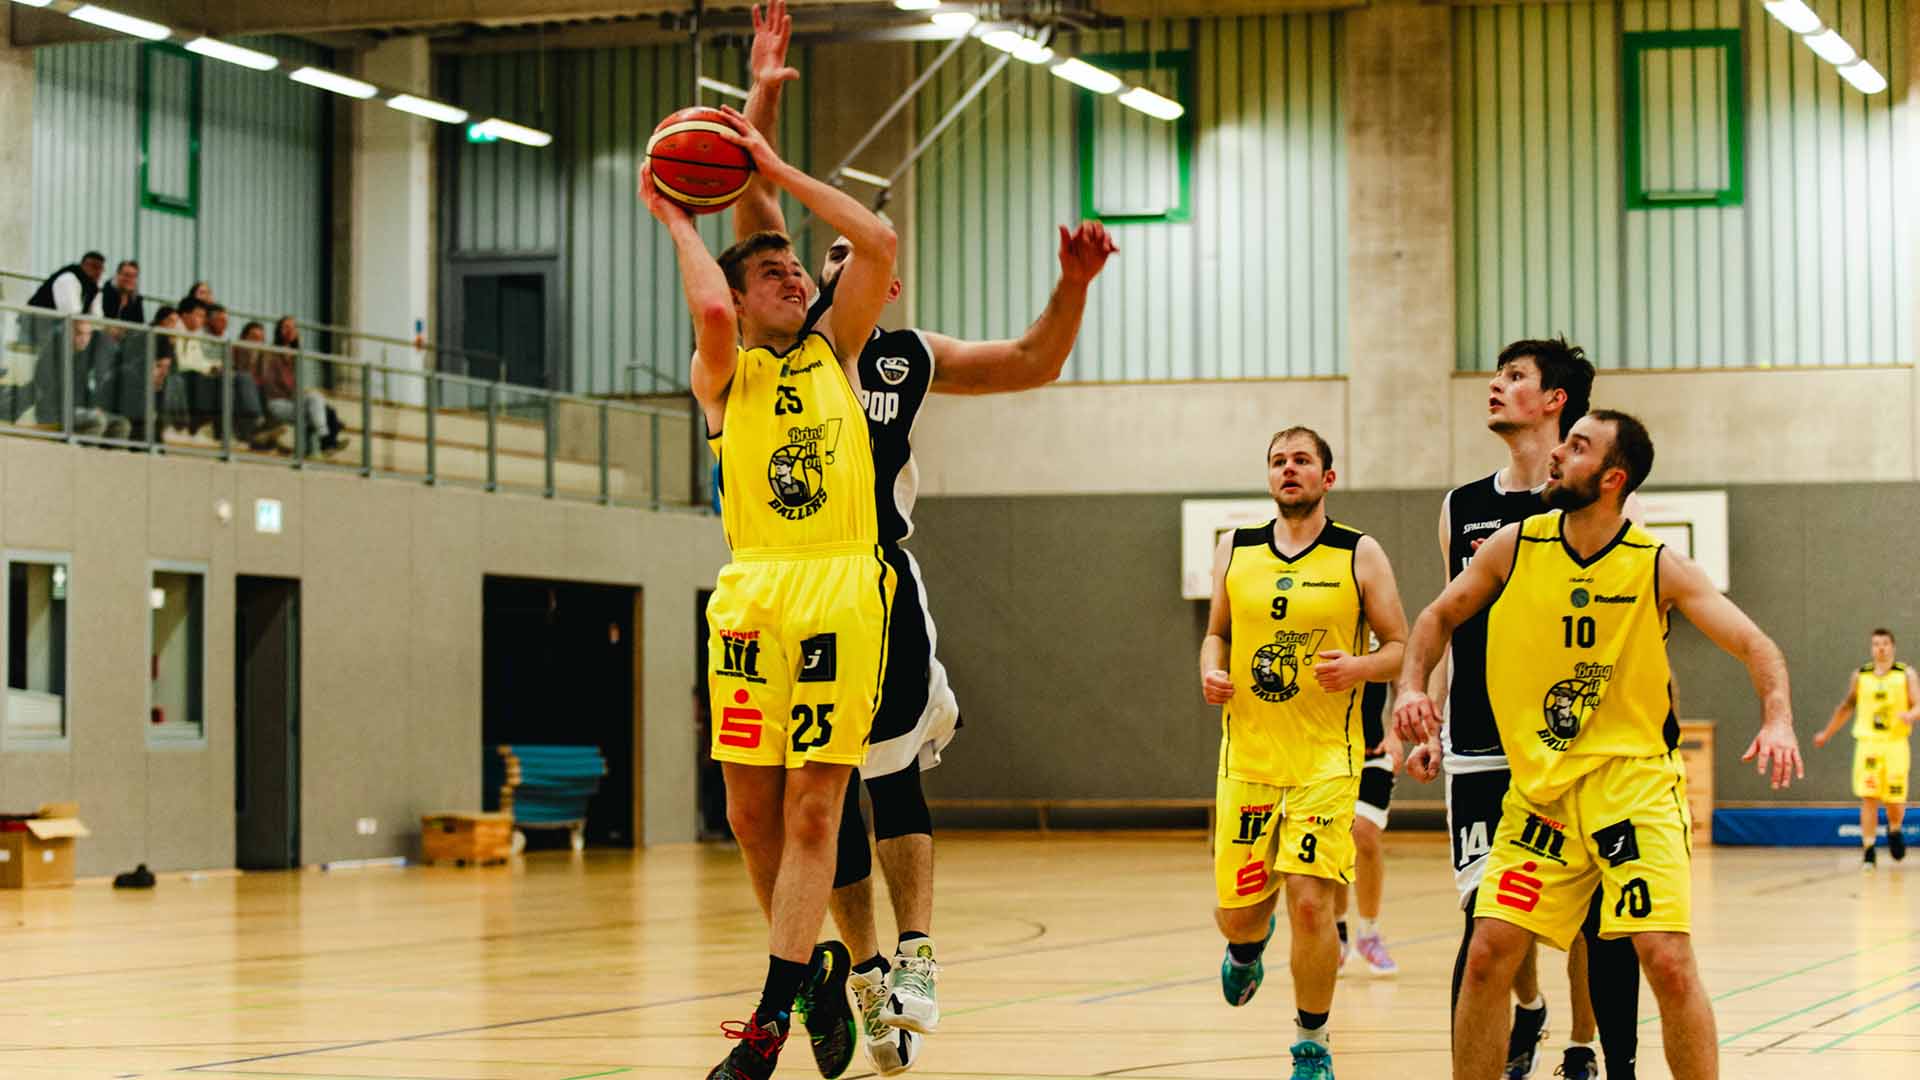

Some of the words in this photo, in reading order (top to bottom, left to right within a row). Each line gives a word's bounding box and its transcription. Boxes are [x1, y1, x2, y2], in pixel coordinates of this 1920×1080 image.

[775, 384, 804, 416] 25
[788, 424, 825, 443] Bring
[805, 441, 817, 456] it
[804, 456, 821, 470] on
[768, 488, 828, 520] BALLERS
[1463, 519, 1503, 535] SPALDING
[1271, 596, 1289, 620] 9
[1274, 630, 1310, 647] Bring
[1562, 615, 1597, 649] 10
[1574, 661, 1614, 682] Bring
[791, 703, 835, 752] 25
[1536, 728, 1575, 752] BALL
[1240, 803, 1274, 813] clever
[1298, 833, 1318, 864] 9
[1458, 820, 1493, 868] 14
[1615, 877, 1652, 918] 10
